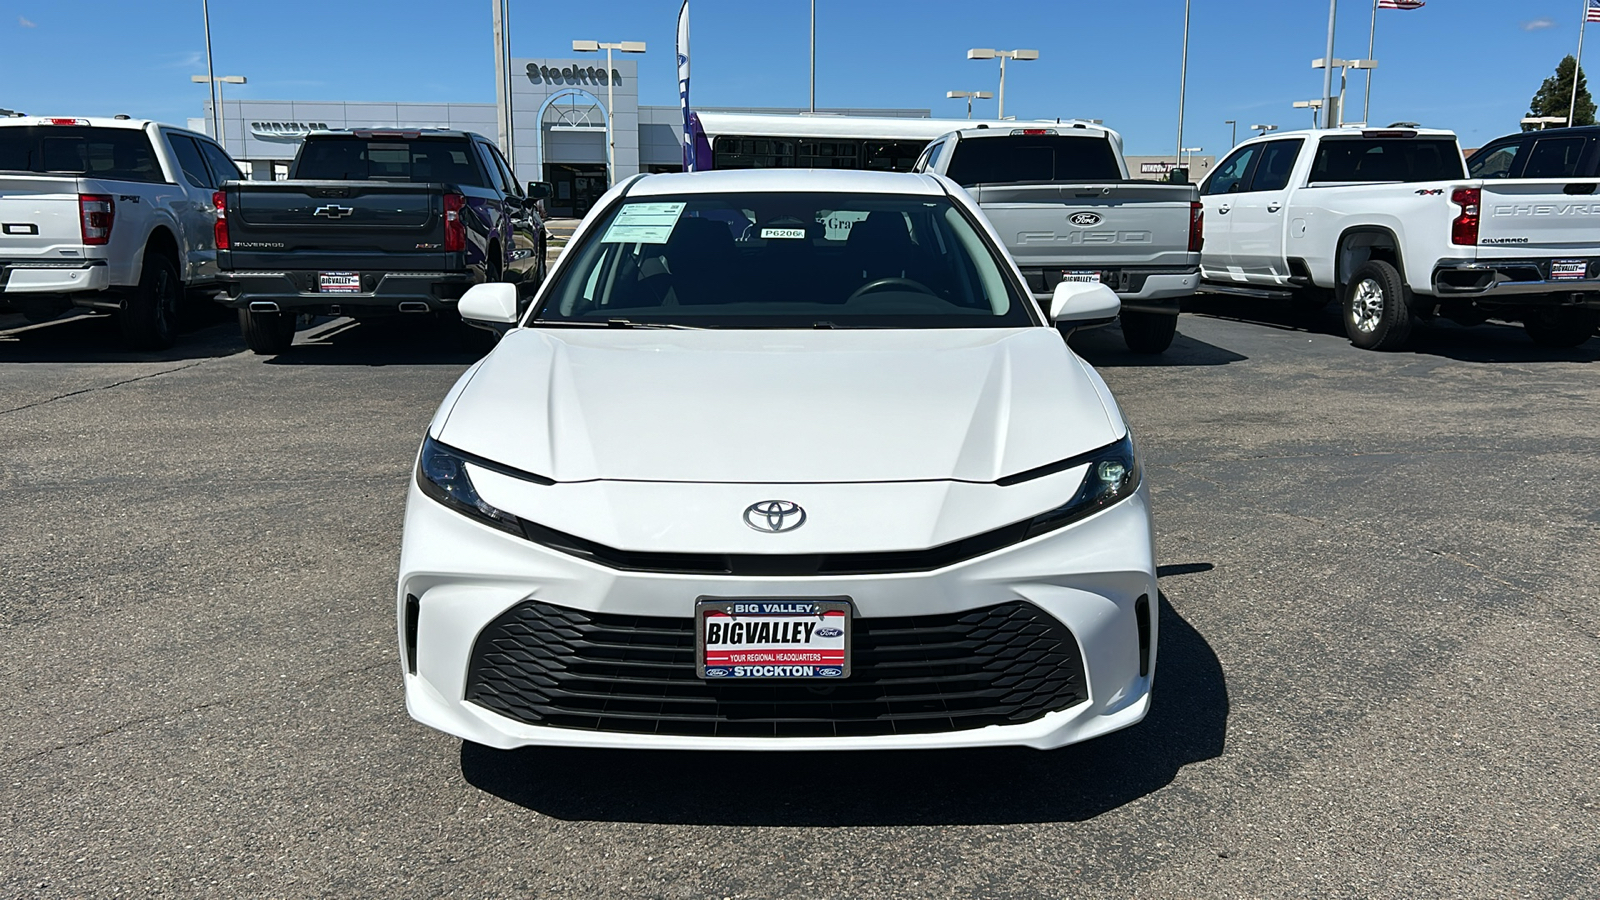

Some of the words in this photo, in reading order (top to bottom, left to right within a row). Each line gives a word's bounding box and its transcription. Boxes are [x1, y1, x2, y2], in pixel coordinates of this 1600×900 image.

[526, 63, 620, 82] Stockton
[1074, 214, 1097, 224] Ford
[1016, 230, 1153, 245] F-150
[735, 604, 759, 613] BIG
[763, 604, 813, 613] VALLEY
[707, 621, 816, 645] BIGVALLEY
[818, 628, 840, 637] Ford
[730, 654, 746, 662] YOUR
[747, 654, 775, 662] REGIONAL
[776, 653, 821, 662] HEADQUARTERS
[734, 666, 814, 677] STOCKTON
